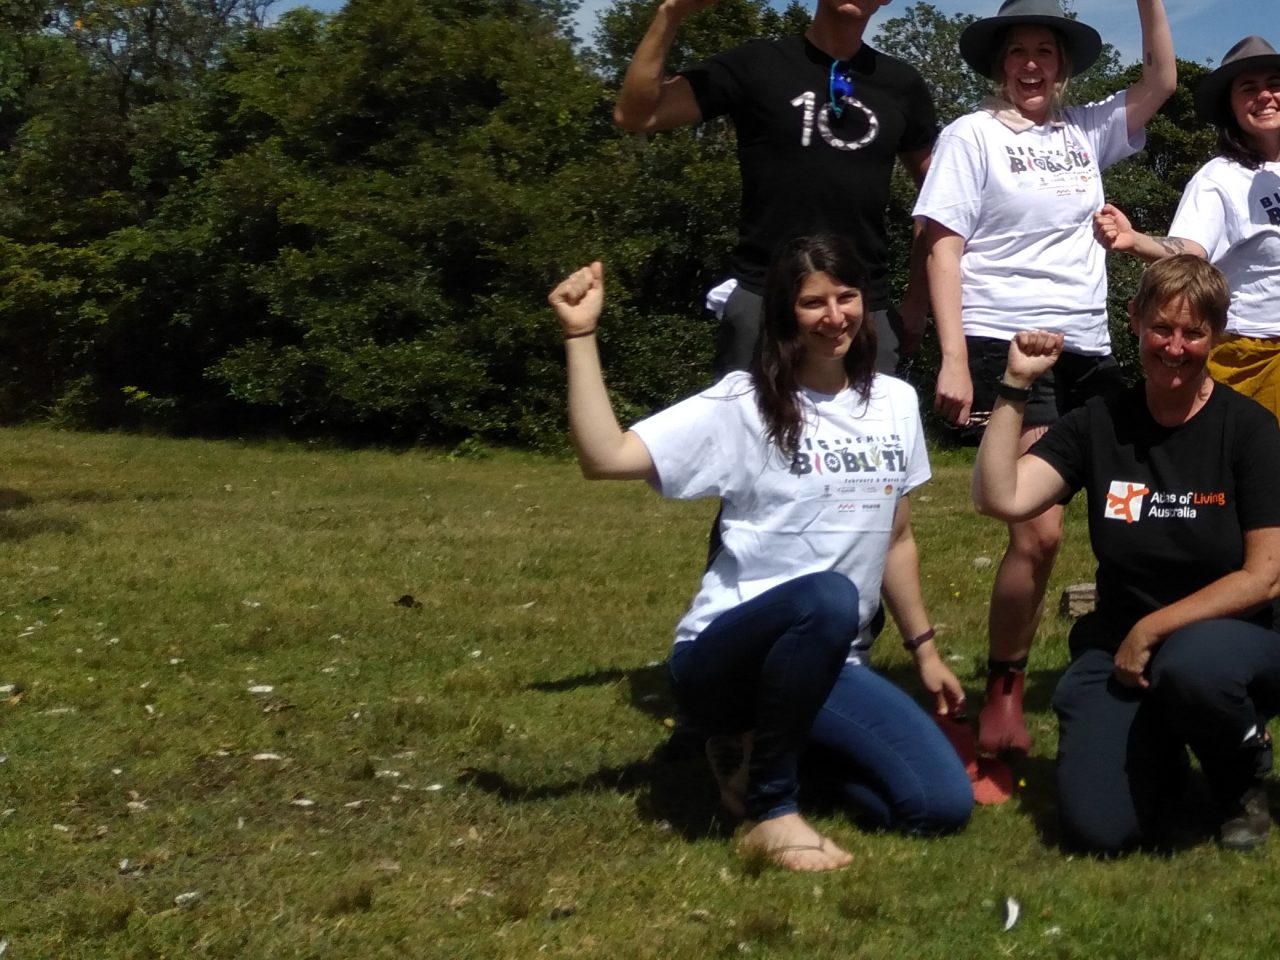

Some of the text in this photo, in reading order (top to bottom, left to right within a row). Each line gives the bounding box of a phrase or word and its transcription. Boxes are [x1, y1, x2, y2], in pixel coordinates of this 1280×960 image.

[790, 91, 880, 151] 10
[1179, 492, 1193, 504] of
[1193, 492, 1226, 506] Living
[1148, 506, 1197, 519] Australia
